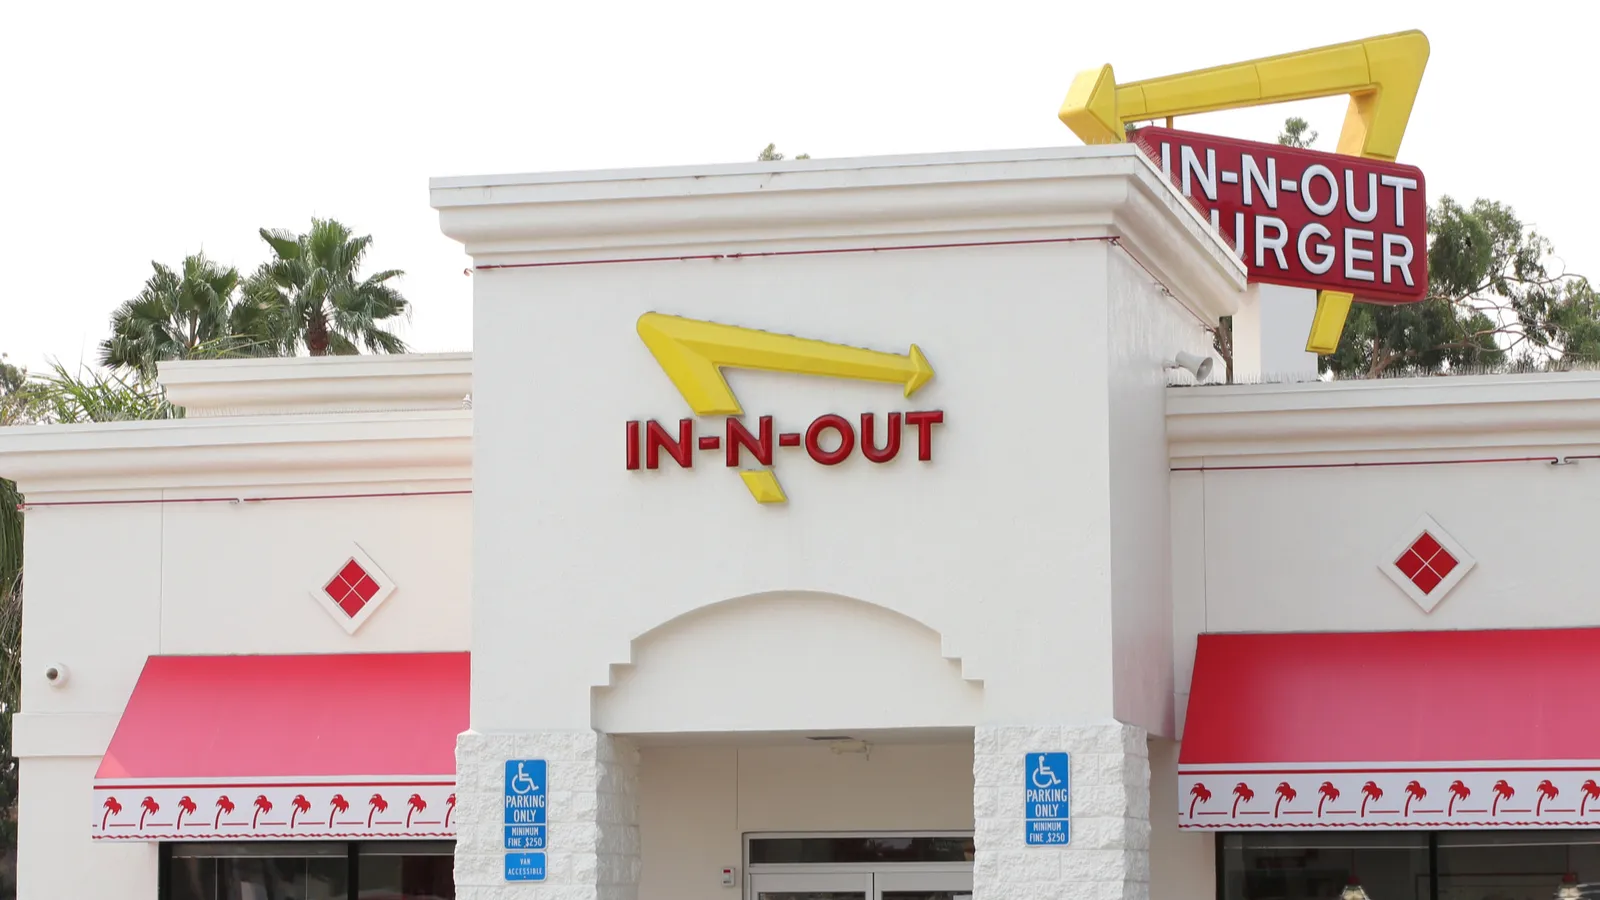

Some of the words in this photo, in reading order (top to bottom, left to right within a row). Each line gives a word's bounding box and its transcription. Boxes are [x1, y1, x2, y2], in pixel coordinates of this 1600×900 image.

[1161, 142, 1417, 227] IN-N-OUT
[1210, 209, 1415, 287] URGER
[626, 410, 944, 470] IN-N-OUT
[506, 794, 545, 808] PARKING
[1026, 789, 1067, 802] PARKING
[513, 809, 536, 822] ONLY
[1035, 804, 1059, 817] ONLY
[511, 827, 539, 836] MINIMUM
[1033, 822, 1061, 831] MINIMUM
[508, 838, 522, 847] FINE
[525, 837, 543, 847] $250
[1029, 833, 1043, 842] FINE
[1047, 832, 1065, 843] $250
[508, 867, 543, 876] ACCESSIBLE
